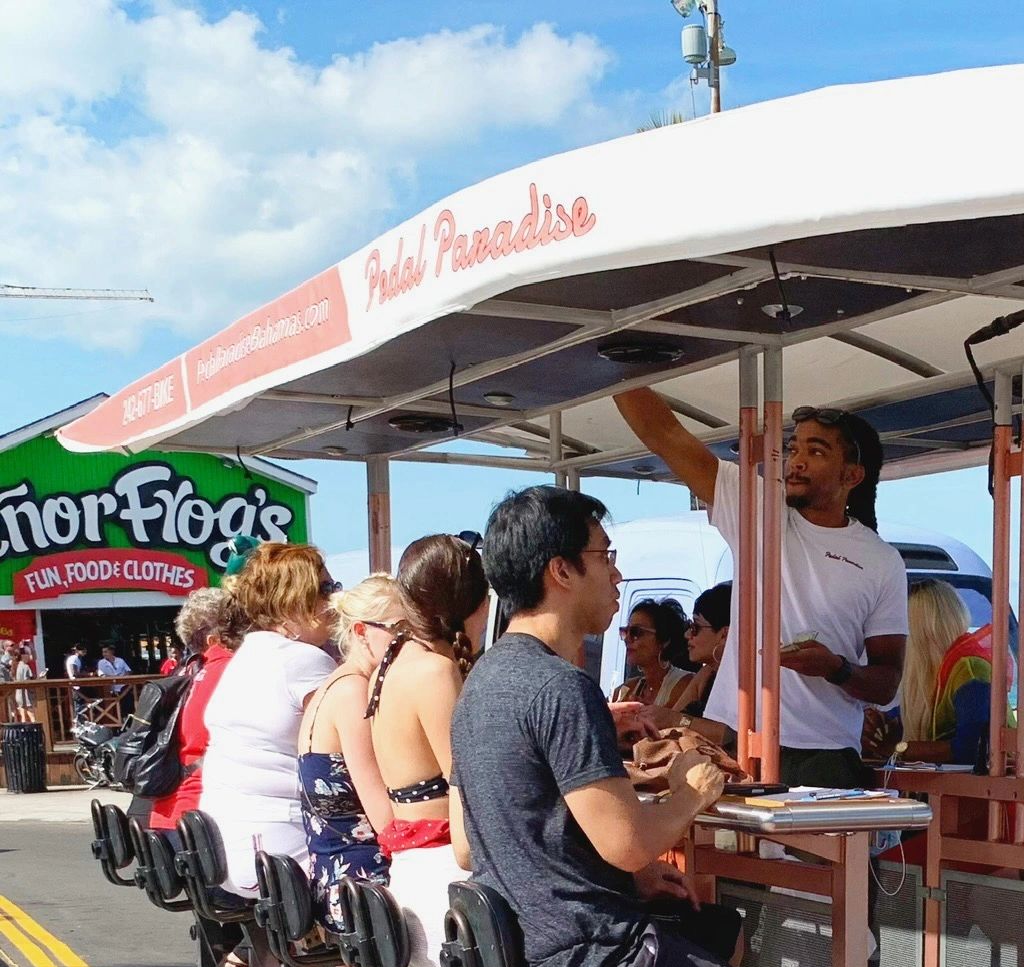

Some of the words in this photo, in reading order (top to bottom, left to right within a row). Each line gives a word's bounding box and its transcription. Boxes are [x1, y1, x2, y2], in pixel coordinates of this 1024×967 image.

[365, 224, 427, 312] Pedal
[434, 183, 597, 277] Paradise
[115, 465, 292, 567] Frog's
[65, 560, 113, 583] FOOD
[123, 560, 195, 588] CLOTHES
